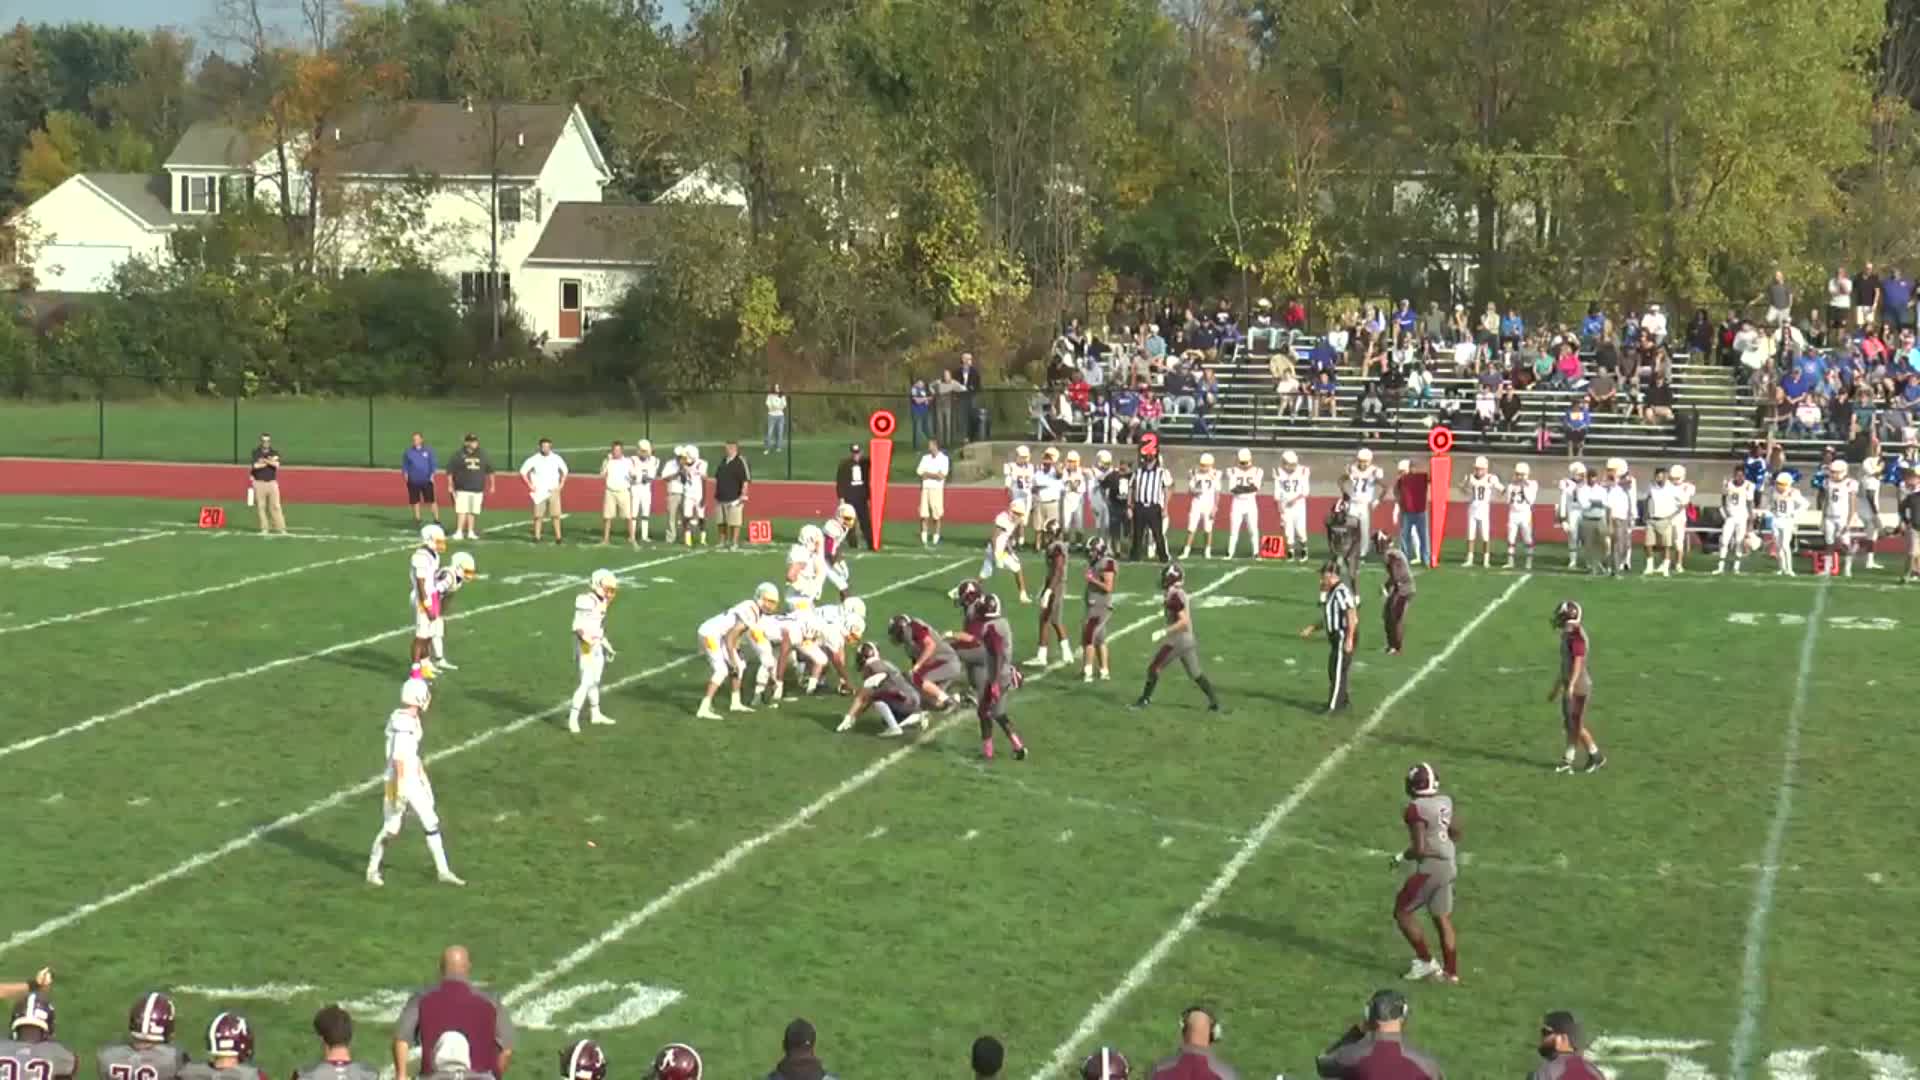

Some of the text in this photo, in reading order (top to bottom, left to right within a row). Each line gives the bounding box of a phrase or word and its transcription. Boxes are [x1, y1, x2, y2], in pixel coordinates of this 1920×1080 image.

[1140, 432, 1158, 455] 2
[201, 507, 222, 525] 20
[750, 521, 770, 540] 30
[1262, 536, 1281, 555] 40
